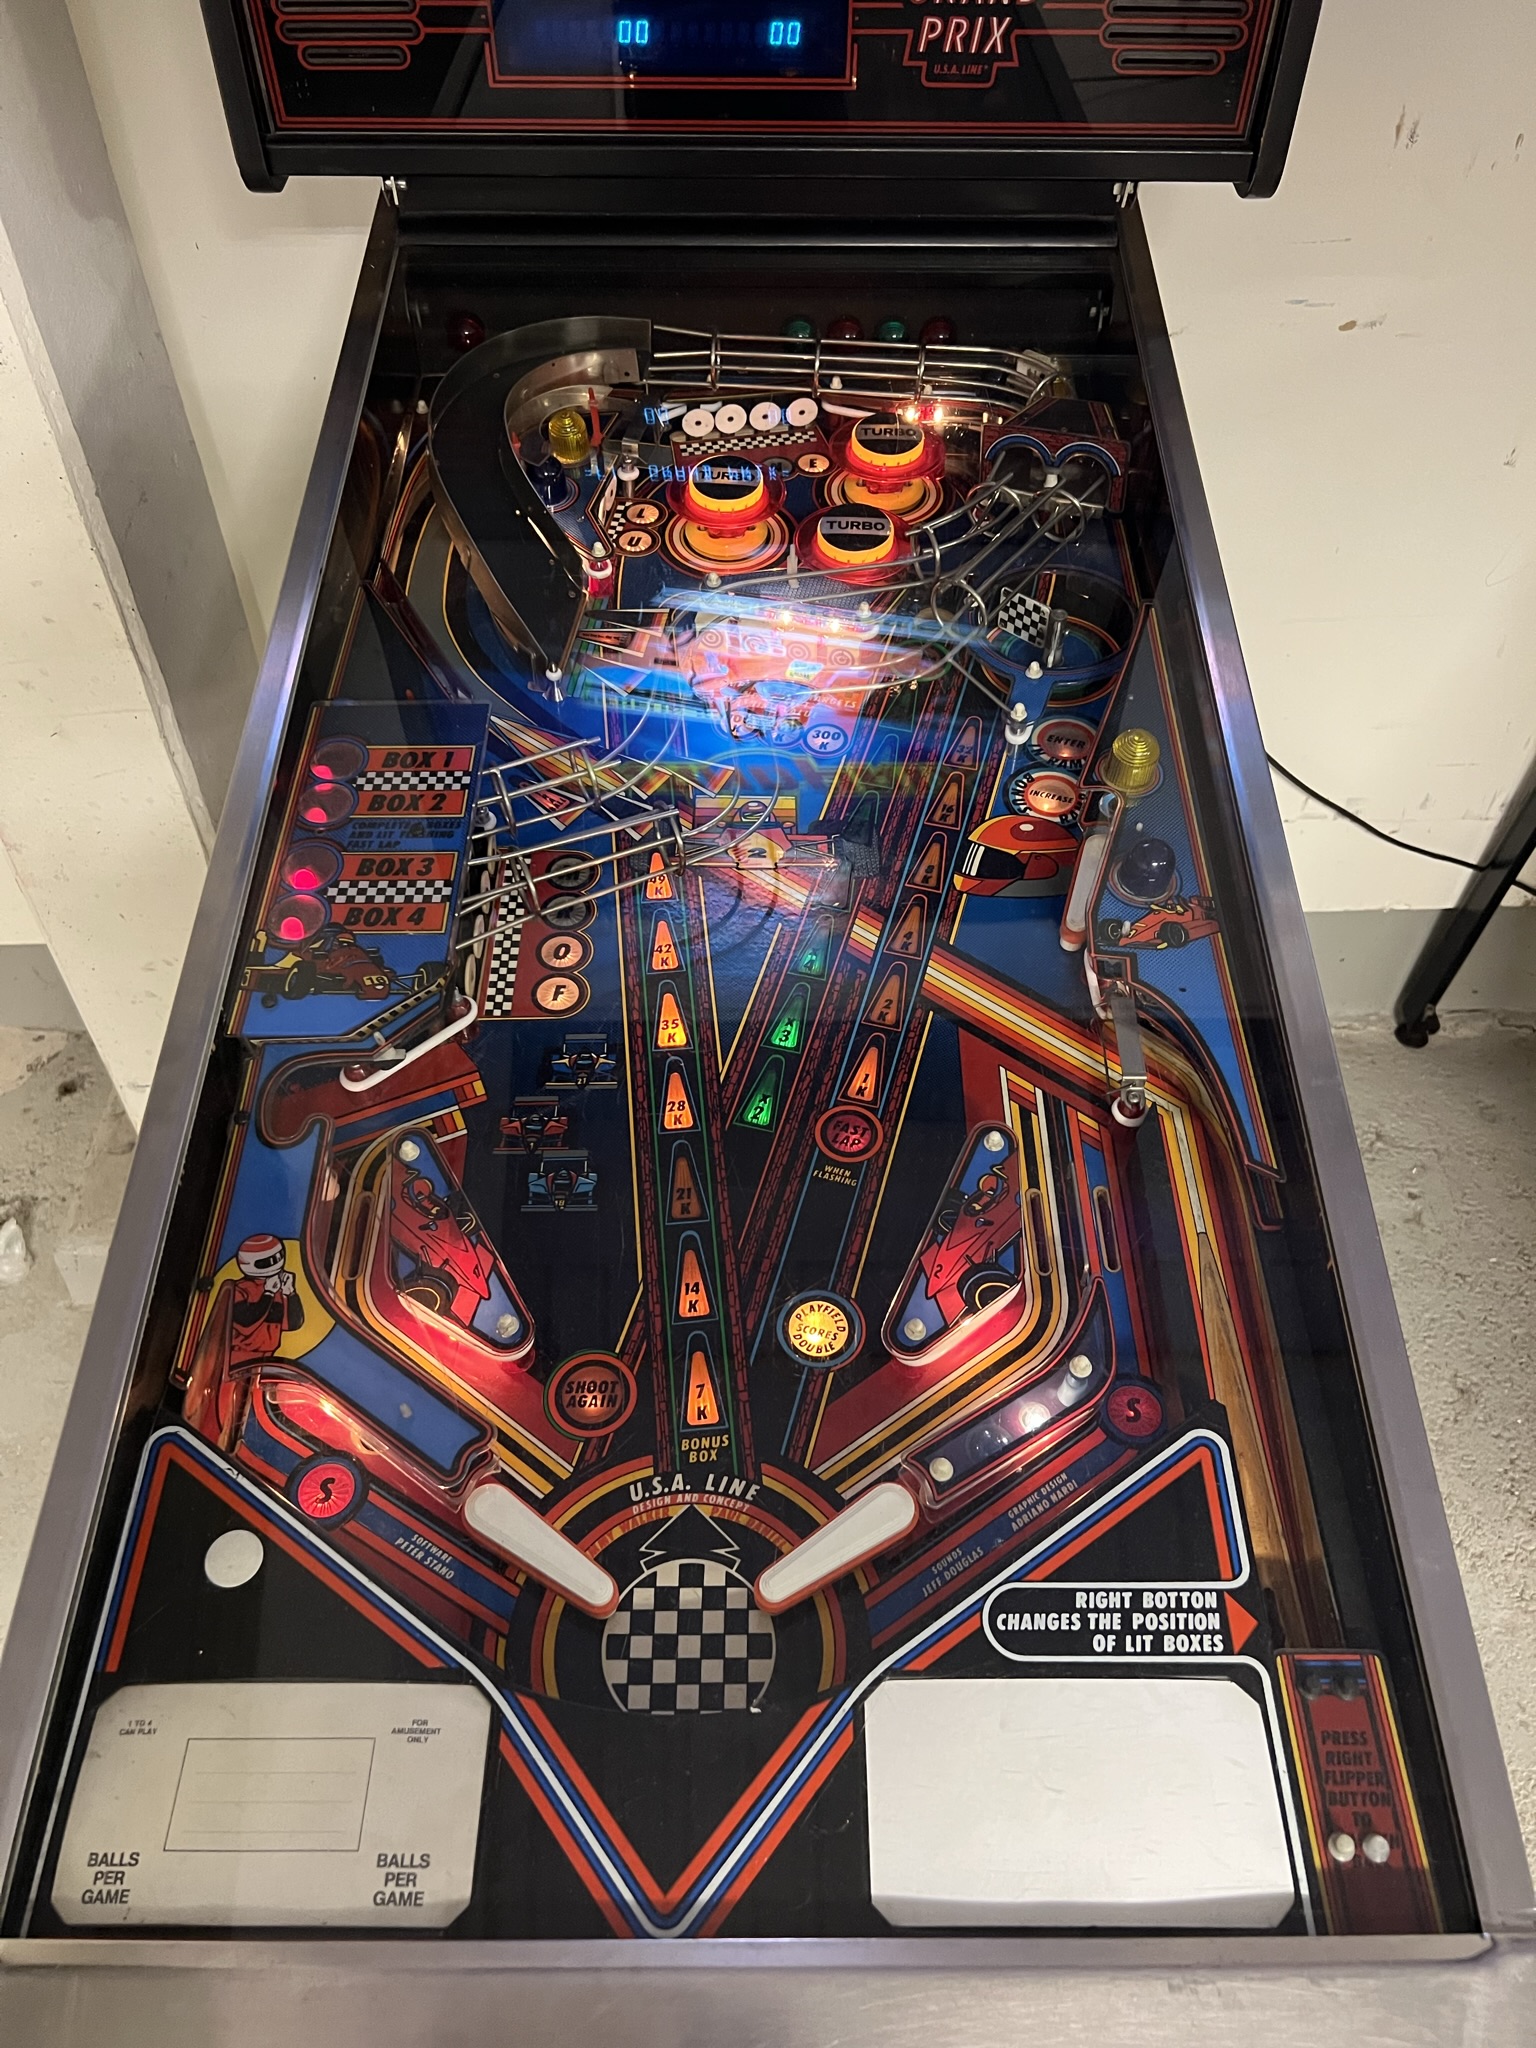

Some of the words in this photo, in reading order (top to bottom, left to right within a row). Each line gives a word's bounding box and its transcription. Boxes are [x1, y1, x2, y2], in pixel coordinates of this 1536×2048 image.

[619, 20, 648, 43] 00
[770, 22, 800, 45] 00
[917, 16, 1012, 53] PRIX
[934, 64, 960, 74] U.S.A.
[861, 427, 917, 437] TURBO
[809, 459, 817, 468] E
[636, 508, 646, 518] L
[826, 520, 886, 531] TURBO
[627, 537, 642, 547] U
[812, 729, 842, 740] 300
[1047, 734, 1086, 749] ENTER
[818, 742, 829, 750] K
[381, 751, 432, 768] BOX
[442, 751, 454, 768] 1
[1011, 772, 1035, 814] BONUS
[1029, 789, 1075, 804] INCREASE
[367, 794, 422, 812] BOX
[428, 793, 447, 811] 2
[942, 804, 954, 813] 16
[940, 813, 950, 822] K
[356, 858, 412, 876] BOX
[416, 858, 435, 876] 3
[923, 875, 932, 884] K
[655, 886, 664, 895] K
[343, 907, 403, 927] BOX
[407, 907, 426, 925] 4
[904, 931, 913, 940] 4
[553, 943, 571, 960] O
[655, 944, 672, 954] 42
[901, 941, 912, 951] K
[661, 956, 669, 966] K
[552, 985, 566, 1001] F
[884, 999, 892, 1009] 2
[878, 1011, 887, 1022] K
[661, 1019, 679, 1030] 35
[667, 1033, 676, 1043] K
[778, 1030, 790, 1043] 3
[863, 1074, 869, 1083] 1
[856, 1086, 868, 1097] K
[667, 1100, 686, 1113] 28
[753, 1107, 765, 1120] 2
[673, 1114, 683, 1126] K
[832, 1120, 870, 1137] FAST
[833, 1134, 861, 1148] LAP
[813, 1170, 857, 1187] FLASHING
[824, 1165, 851, 1177] WHEN
[676, 1188, 692, 1200] 21
[681, 1202, 691, 1215] K
[934, 1264, 943, 1279] 2
[684, 1282, 700, 1295] 14
[688, 1300, 699, 1313] K
[795, 1304, 846, 1332] PLAYFIELD
[796, 1324, 839, 1340] SCORES
[793, 1334, 835, 1354] DOUBLE
[565, 1380, 620, 1395] SHOOT
[696, 1384, 705, 1399] 7
[566, 1393, 619, 1409] AGAIN
[697, 1405, 708, 1420] K
[1126, 1398, 1140, 1422] S
[681, 1435, 729, 1451] BONUS
[689, 1449, 718, 1463] BOX
[315, 1478, 335, 1503] S
[629, 1473, 690, 1502] U.S.A.
[705, 1473, 760, 1501] LINE
[632, 1495, 671, 1514] DESIGN
[676, 1493, 699, 1503] AND
[703, 1494, 750, 1513] CONCEPT
[1007, 1492, 1040, 1520] GRAPHIC
[1040, 1472, 1068, 1495] DESIGN
[1011, 1501, 1050, 1533] ADRIANO
[411, 1534, 453, 1563] SOFTWARE
[394, 1537, 425, 1560] PETER
[424, 1556, 455, 1580] STANO
[931, 1547, 963, 1575] SOUNDS
[922, 1578, 942, 1598] JEFF
[943, 1546, 985, 1582] DOUGLAS
[1075, 1591, 1132, 1608] RIGHT
[1142, 1591, 1217, 1609] BOTTON
[996, 1613, 1081, 1630] CHANGES
[1088, 1613, 1121, 1630] THE
[1132, 1613, 1220, 1630] POSITION
[1093, 1635, 1116, 1652] OF
[1125, 1635, 1153, 1652] LIT
[1164, 1635, 1224, 1652] BOXES
[119, 1728, 135, 1736] CAN
[1321, 1730, 1367, 1745] PRESS
[406, 1736, 429, 1744] ONLY
[1325, 1751, 1372, 1766] RIGHT
[1324, 1771, 1387, 1786] FLIPPER
[1328, 1791, 1391, 1807] BUTTON
[1352, 1811, 1371, 1827] TO
[87, 1852, 140, 1867] BALLS
[376, 1853, 431, 1868] BALLS
[93, 1871, 125, 1886] PER
[384, 1873, 418, 1887] PER
[81, 1889, 130, 1904] GAME
[373, 1891, 424, 1907] GAME
